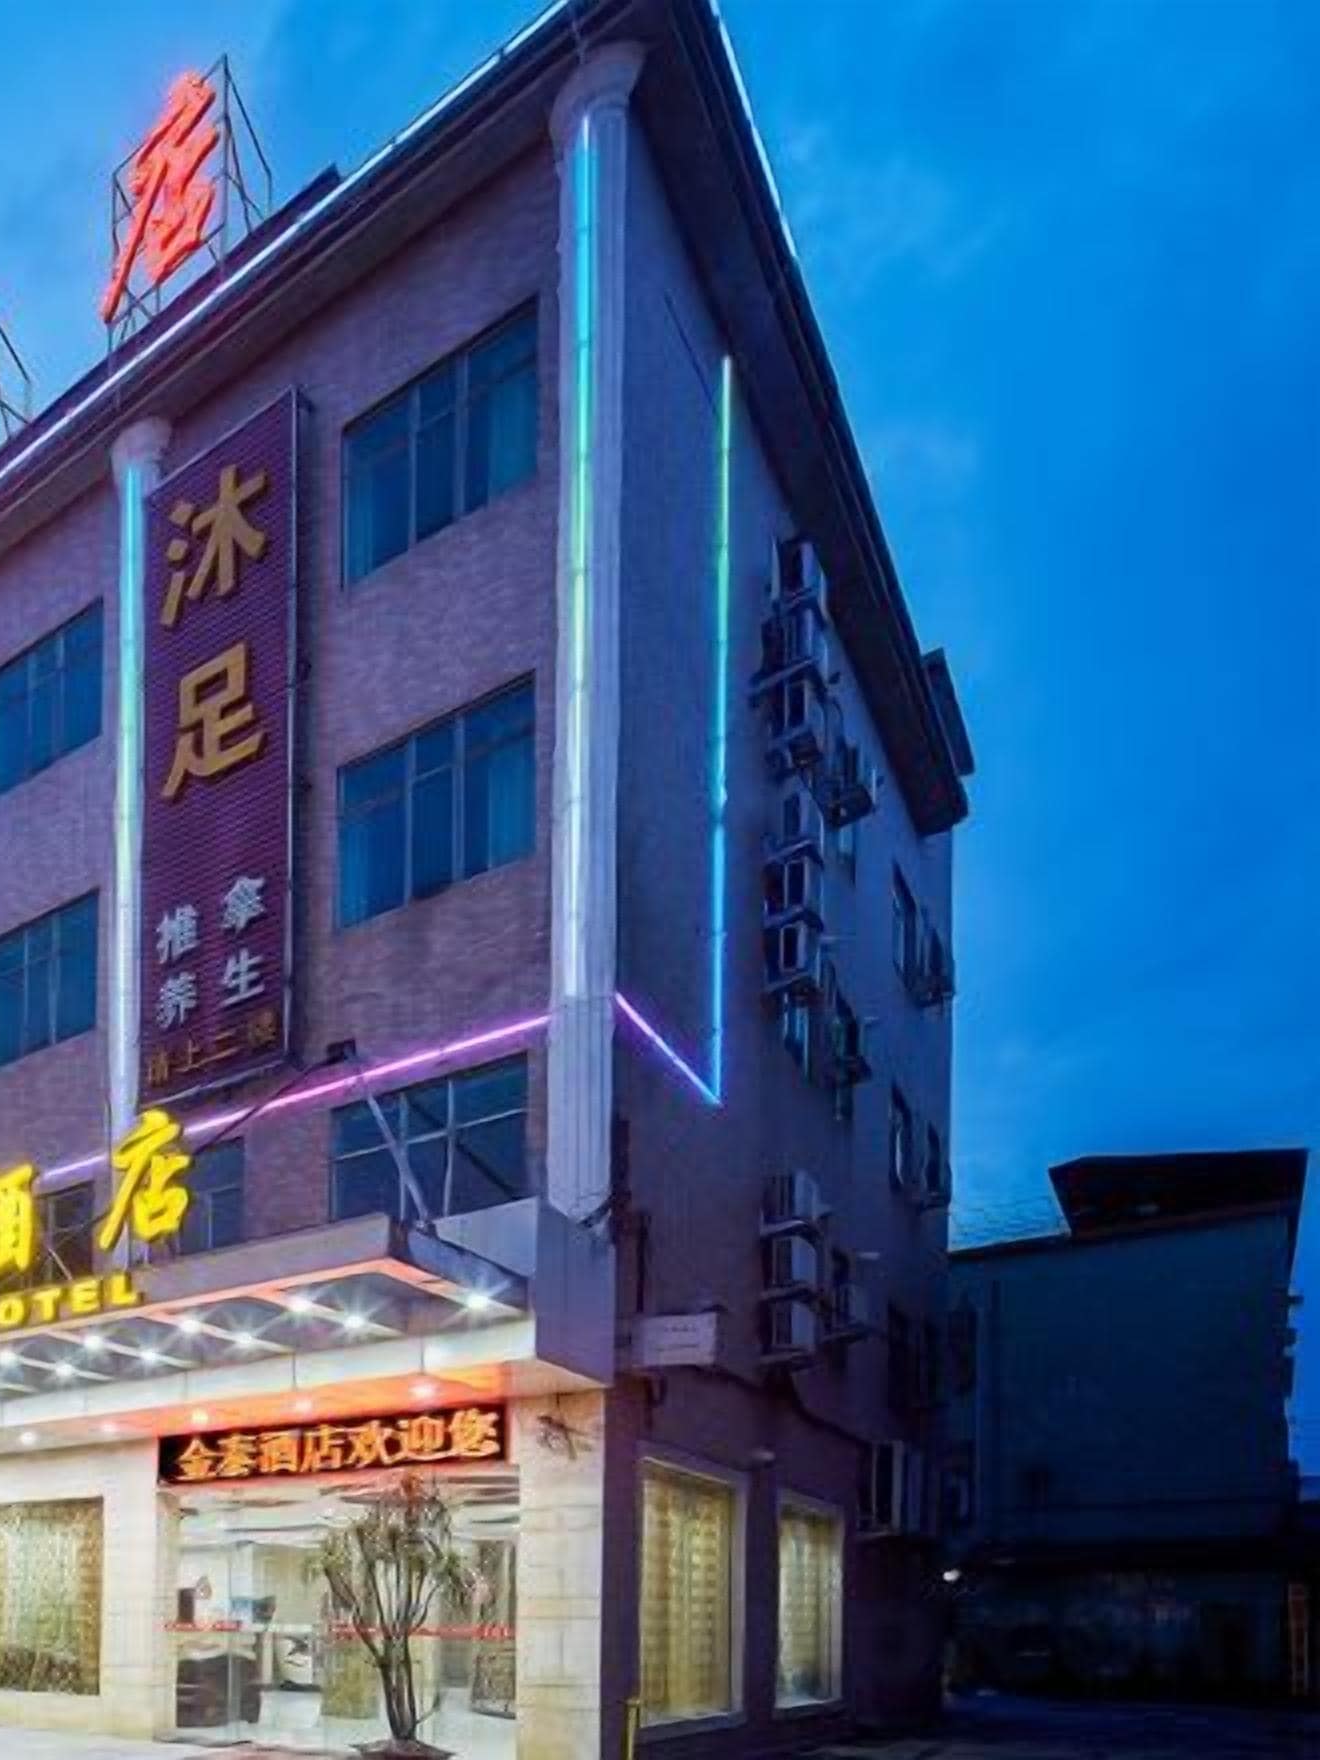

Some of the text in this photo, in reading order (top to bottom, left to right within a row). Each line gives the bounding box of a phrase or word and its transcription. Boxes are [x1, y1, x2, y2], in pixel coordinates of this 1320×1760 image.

[160, 463, 267, 799] 沐足
[176, 1408, 502, 1482] 金泰酒店欢迎您
